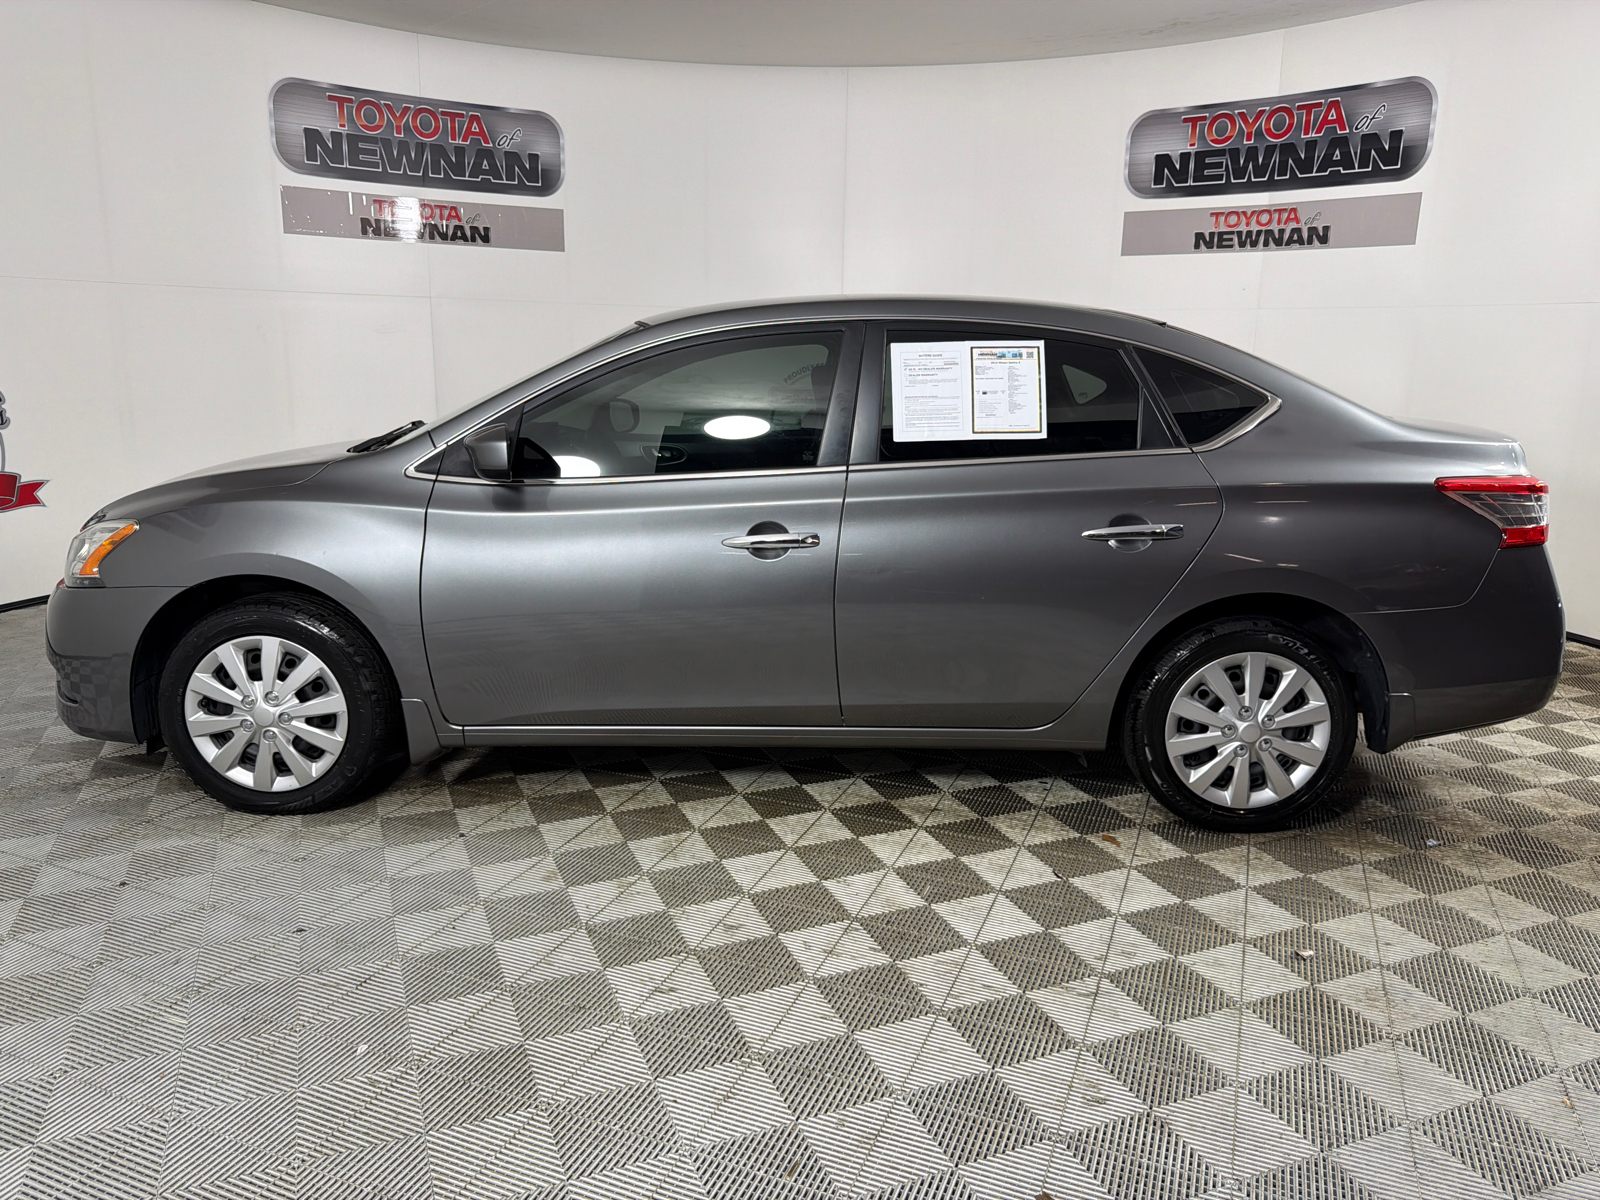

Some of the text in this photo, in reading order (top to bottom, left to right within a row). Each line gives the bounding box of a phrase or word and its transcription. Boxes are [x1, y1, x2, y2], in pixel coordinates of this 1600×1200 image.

[328, 93, 523, 148] TOYOTA of
[1182, 97, 1387, 148] TOYOTA of
[303, 127, 541, 186] NEWNAN
[1152, 128, 1404, 188] NEWNAN
[372, 199, 481, 225] TOOTA of
[1210, 207, 1322, 229] TOYOTA of
[360, 217, 491, 244] NENAN
[1193, 225, 1331, 250] NEWNAN
[782, 363, 815, 384] PROUDLY
